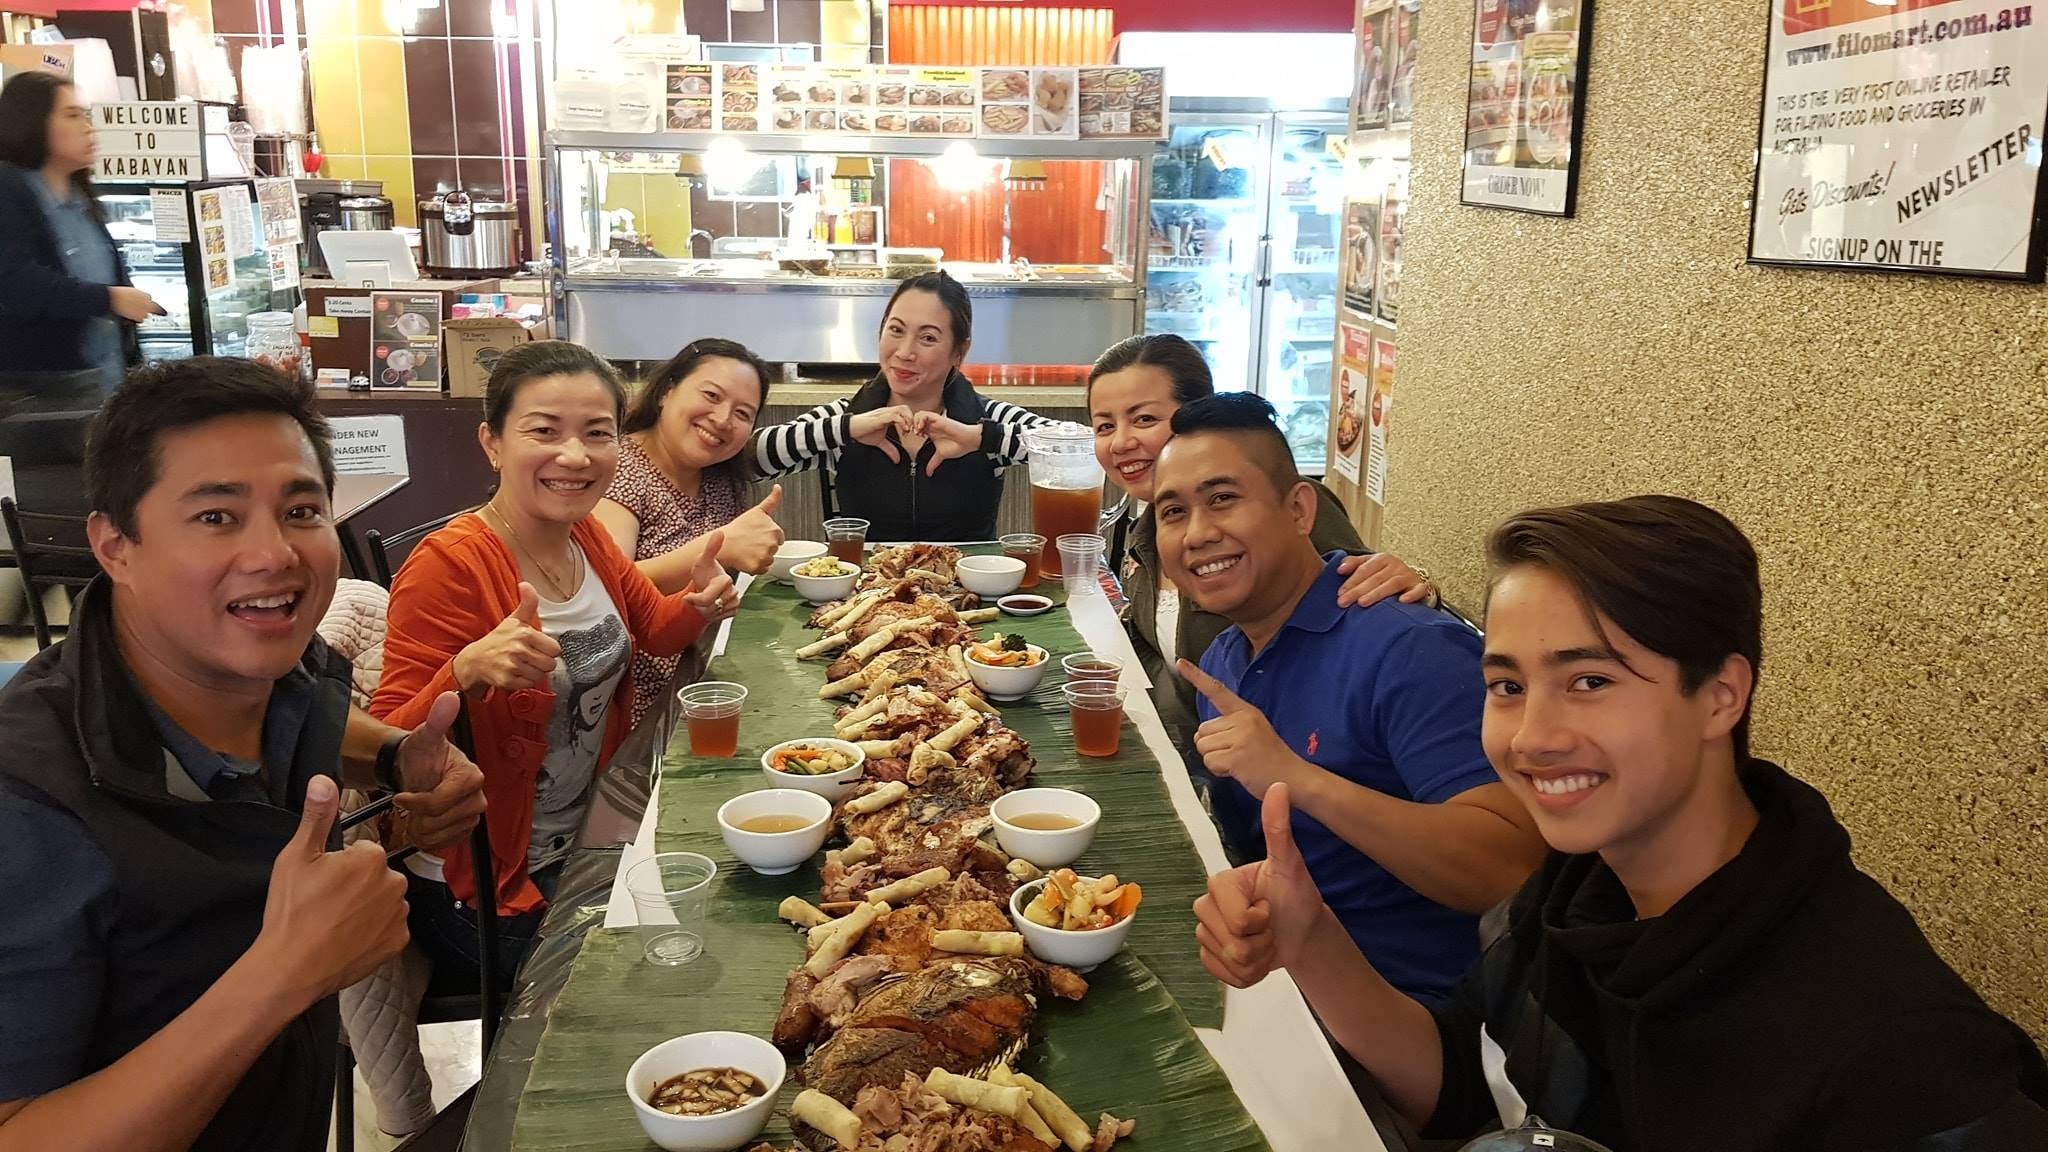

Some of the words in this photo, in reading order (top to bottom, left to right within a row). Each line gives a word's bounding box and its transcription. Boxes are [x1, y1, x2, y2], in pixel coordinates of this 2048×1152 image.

[1786, 5, 2032, 66] www.filomart.com.au
[1777, 96, 1797, 113] THIS
[1798, 94, 1807, 109] IS
[1809, 91, 1828, 107] THE
[1833, 87, 1861, 104] VERY
[1863, 81, 1893, 101] FIRST
[1895, 75, 1942, 97] ONLINE
[1945, 66, 2012, 92] RETAILER
[103, 106, 188, 125] WELCOME
[1774, 116, 1793, 134] FOR
[1838, 107, 1867, 127] FOOD
[1869, 105, 1894, 124] AND
[1899, 98, 1965, 122] GROCERIES
[1968, 96, 1986, 116] IN
[135, 132, 156, 150] TO
[103, 158, 188, 176] KABAYAN
[1896, 123, 2032, 223] NEWSLETTER
[1487, 174, 1517, 195] ORDER
[1519, 176, 1545, 198] NOW!
[1778, 187, 1808, 226] Gets
[1811, 160, 1897, 210] Discounts!
[1807, 237, 1868, 262] SIGNUP
[1874, 239, 1901, 264] ON
[1908, 240, 1944, 265] THE
[331, 431, 355, 440] NDER
[357, 429, 379, 438] NEW
[335, 444, 387, 454] NAGEMENT
